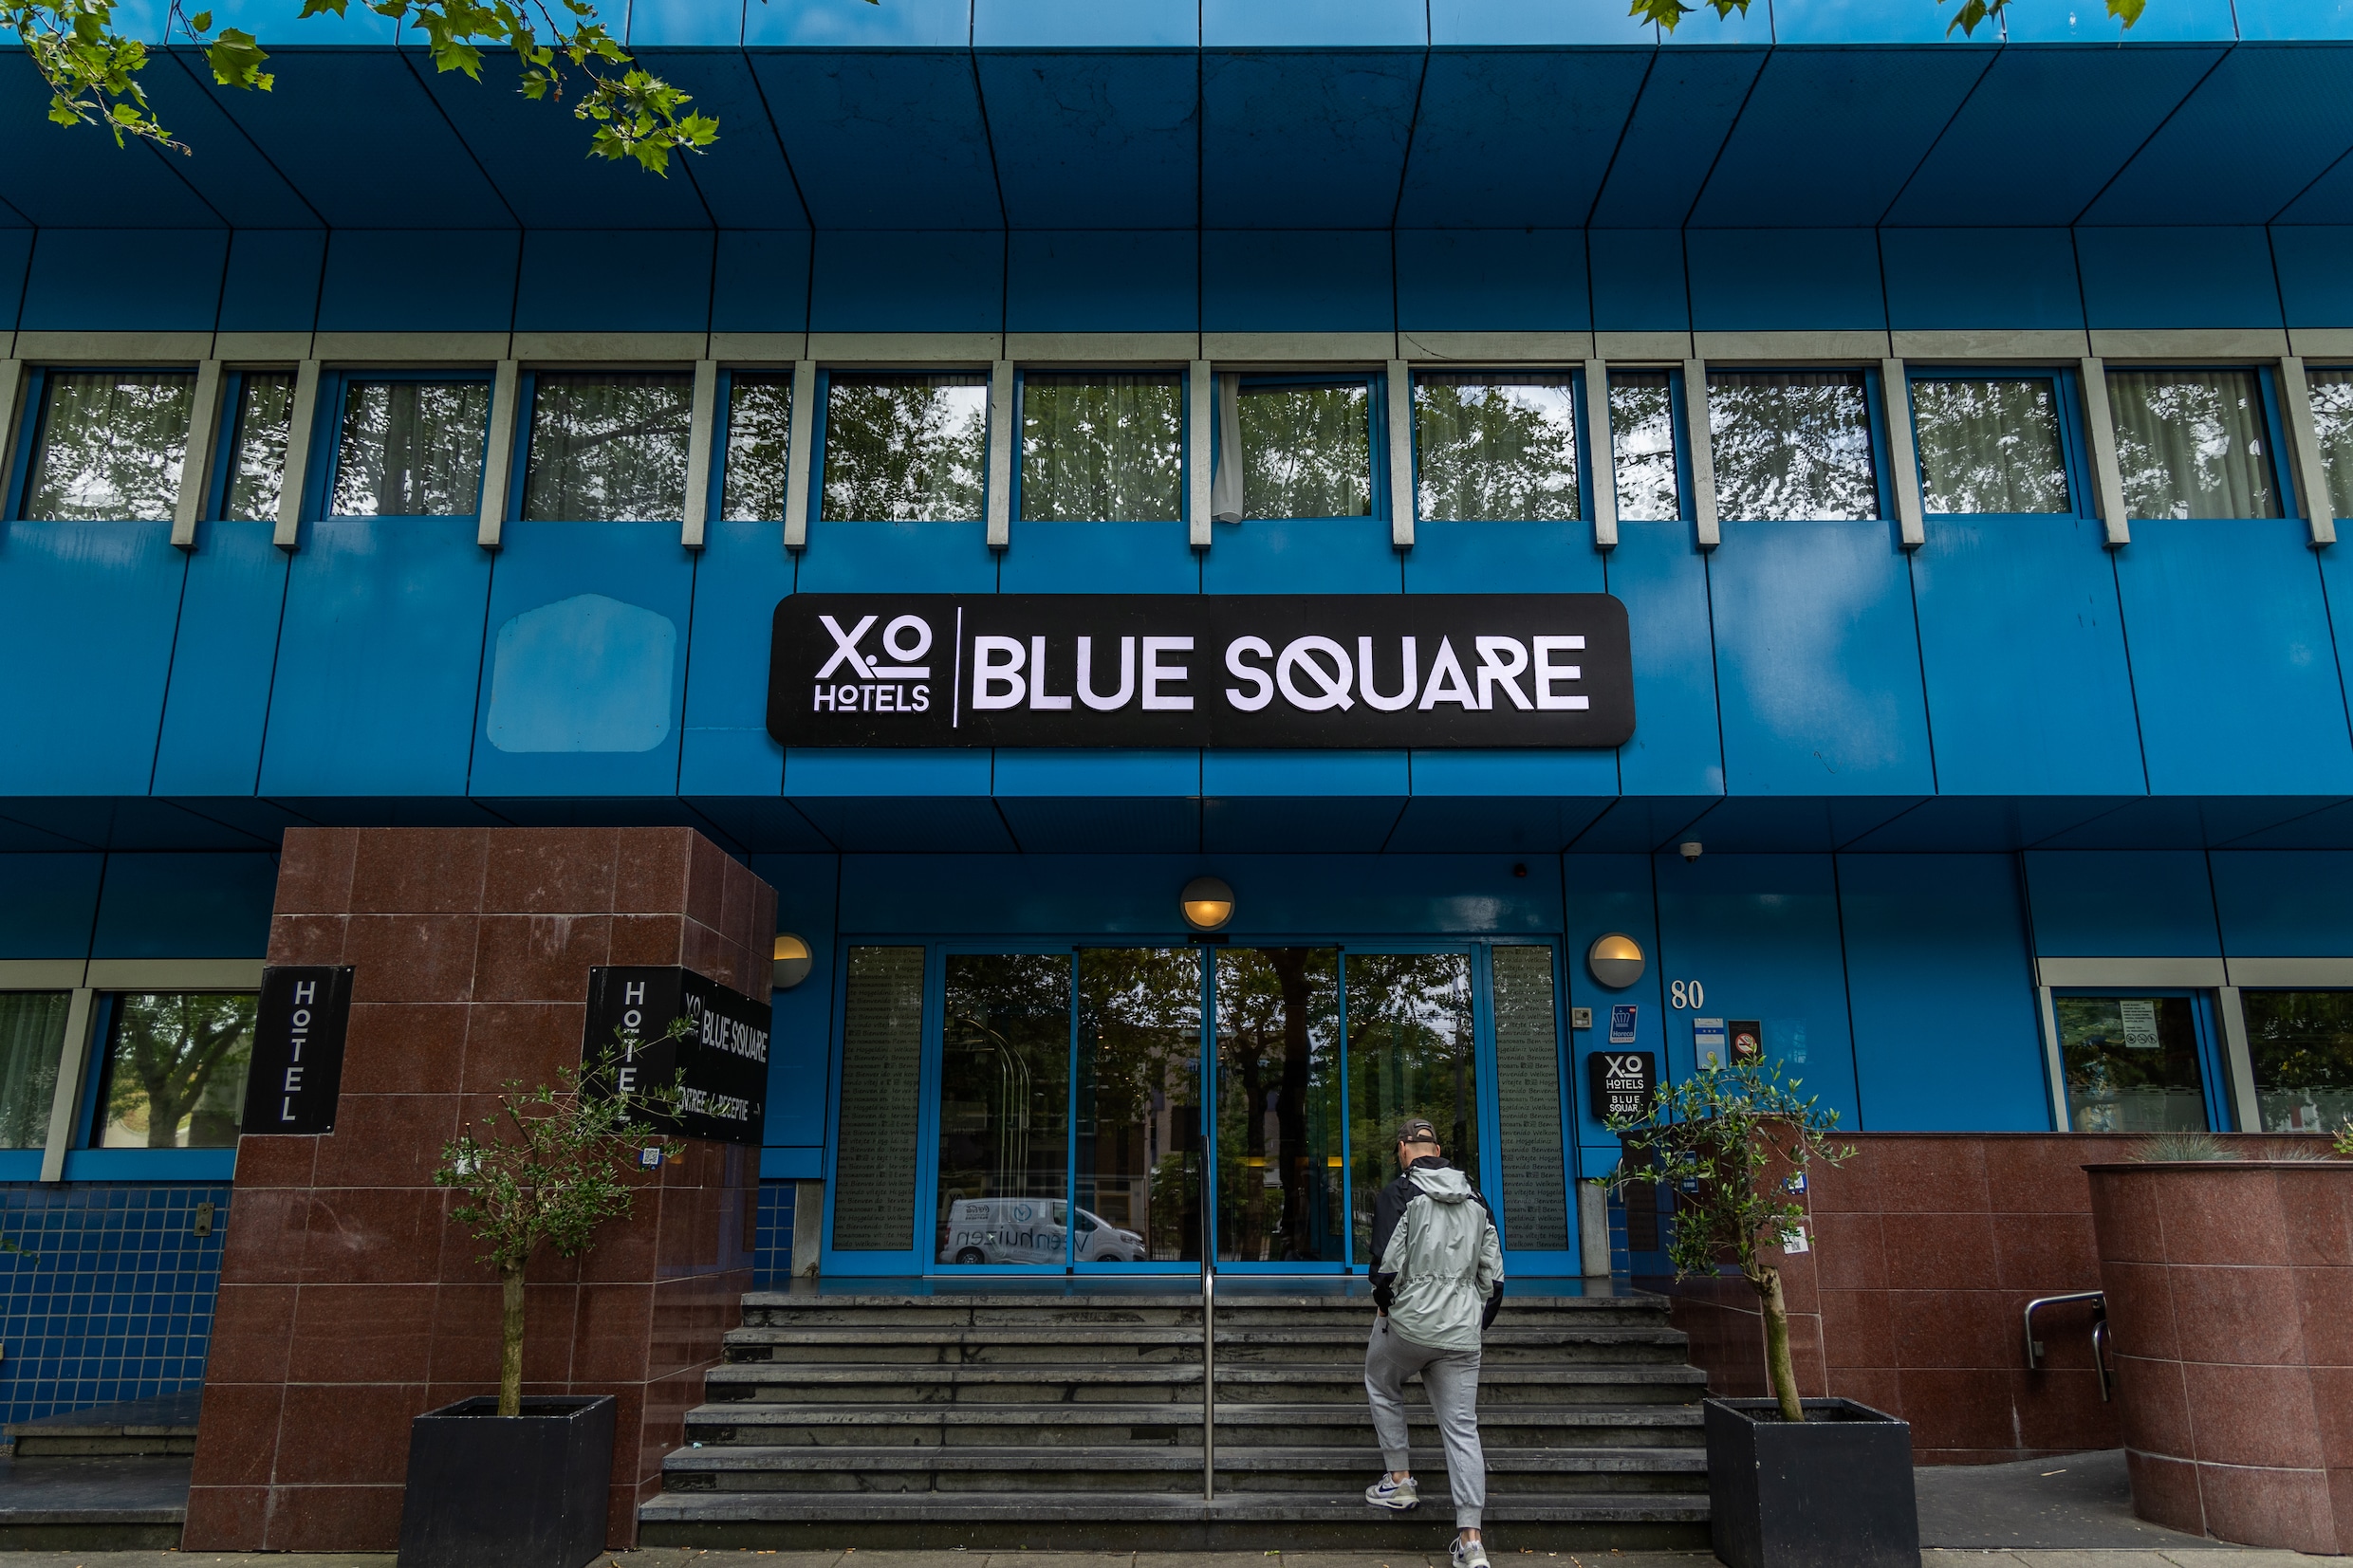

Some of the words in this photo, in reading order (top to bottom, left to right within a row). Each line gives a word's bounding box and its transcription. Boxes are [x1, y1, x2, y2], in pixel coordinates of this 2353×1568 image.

[973, 636, 1195, 710] BLUE
[1225, 635, 1590, 712] SQUARE
[813, 684, 931, 712] HOTELS
[1671, 979, 1704, 1009] 80
[282, 981, 316, 1121] HOTEL
[702, 1009, 731, 1051] BLUE
[731, 1020, 769, 1063] SQUARE
[1605, 1079, 1644, 1089] HOTELS
